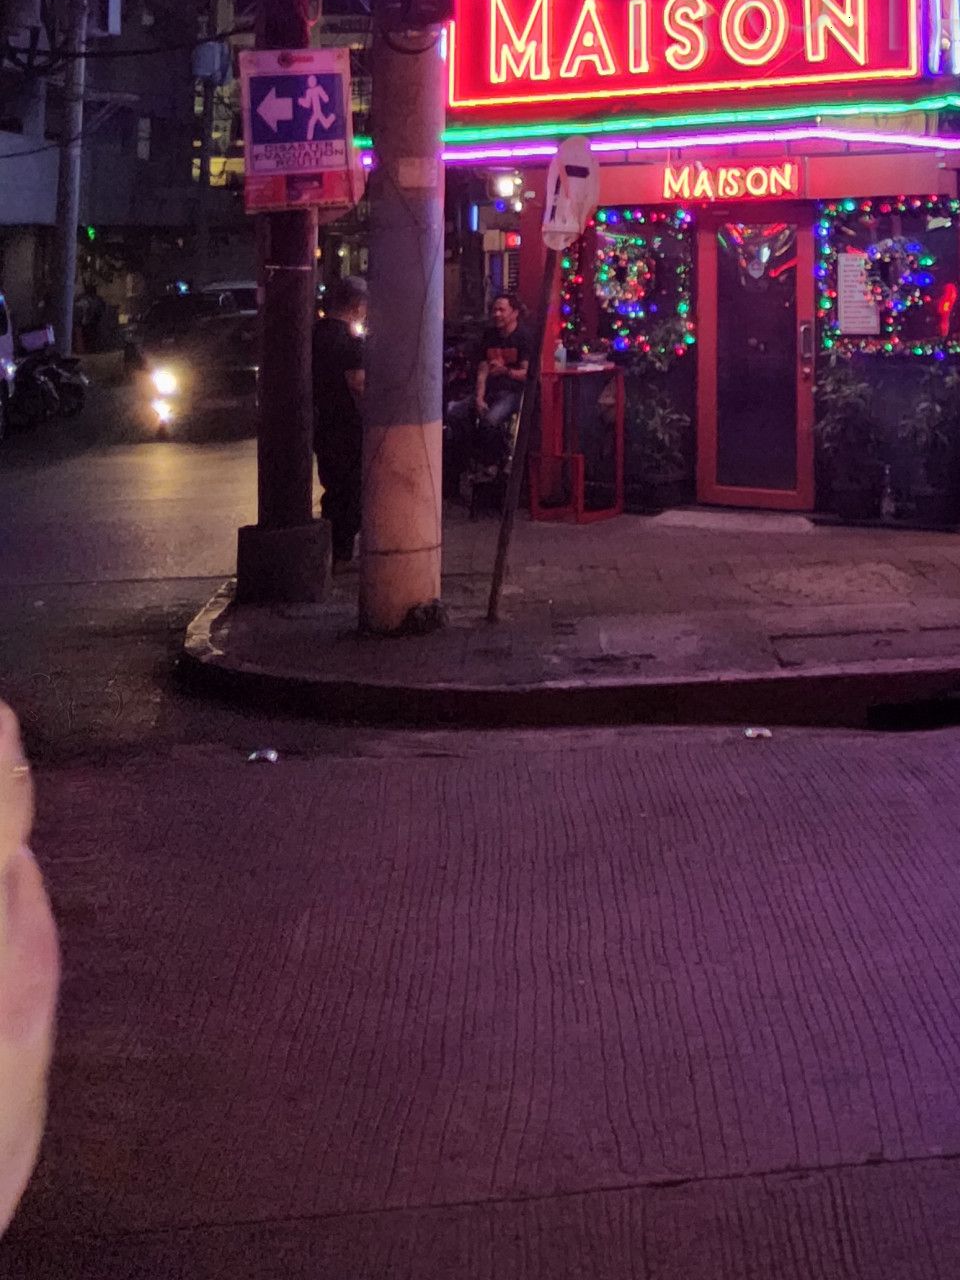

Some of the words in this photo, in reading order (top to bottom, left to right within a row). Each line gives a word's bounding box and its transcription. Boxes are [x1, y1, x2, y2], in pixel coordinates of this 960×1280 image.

[264, 142, 334, 153] DISASTER
[254, 149, 343, 161] EVACUATION
[275, 158, 320, 168] ROUTE
[662, 164, 796, 200] MAISON
